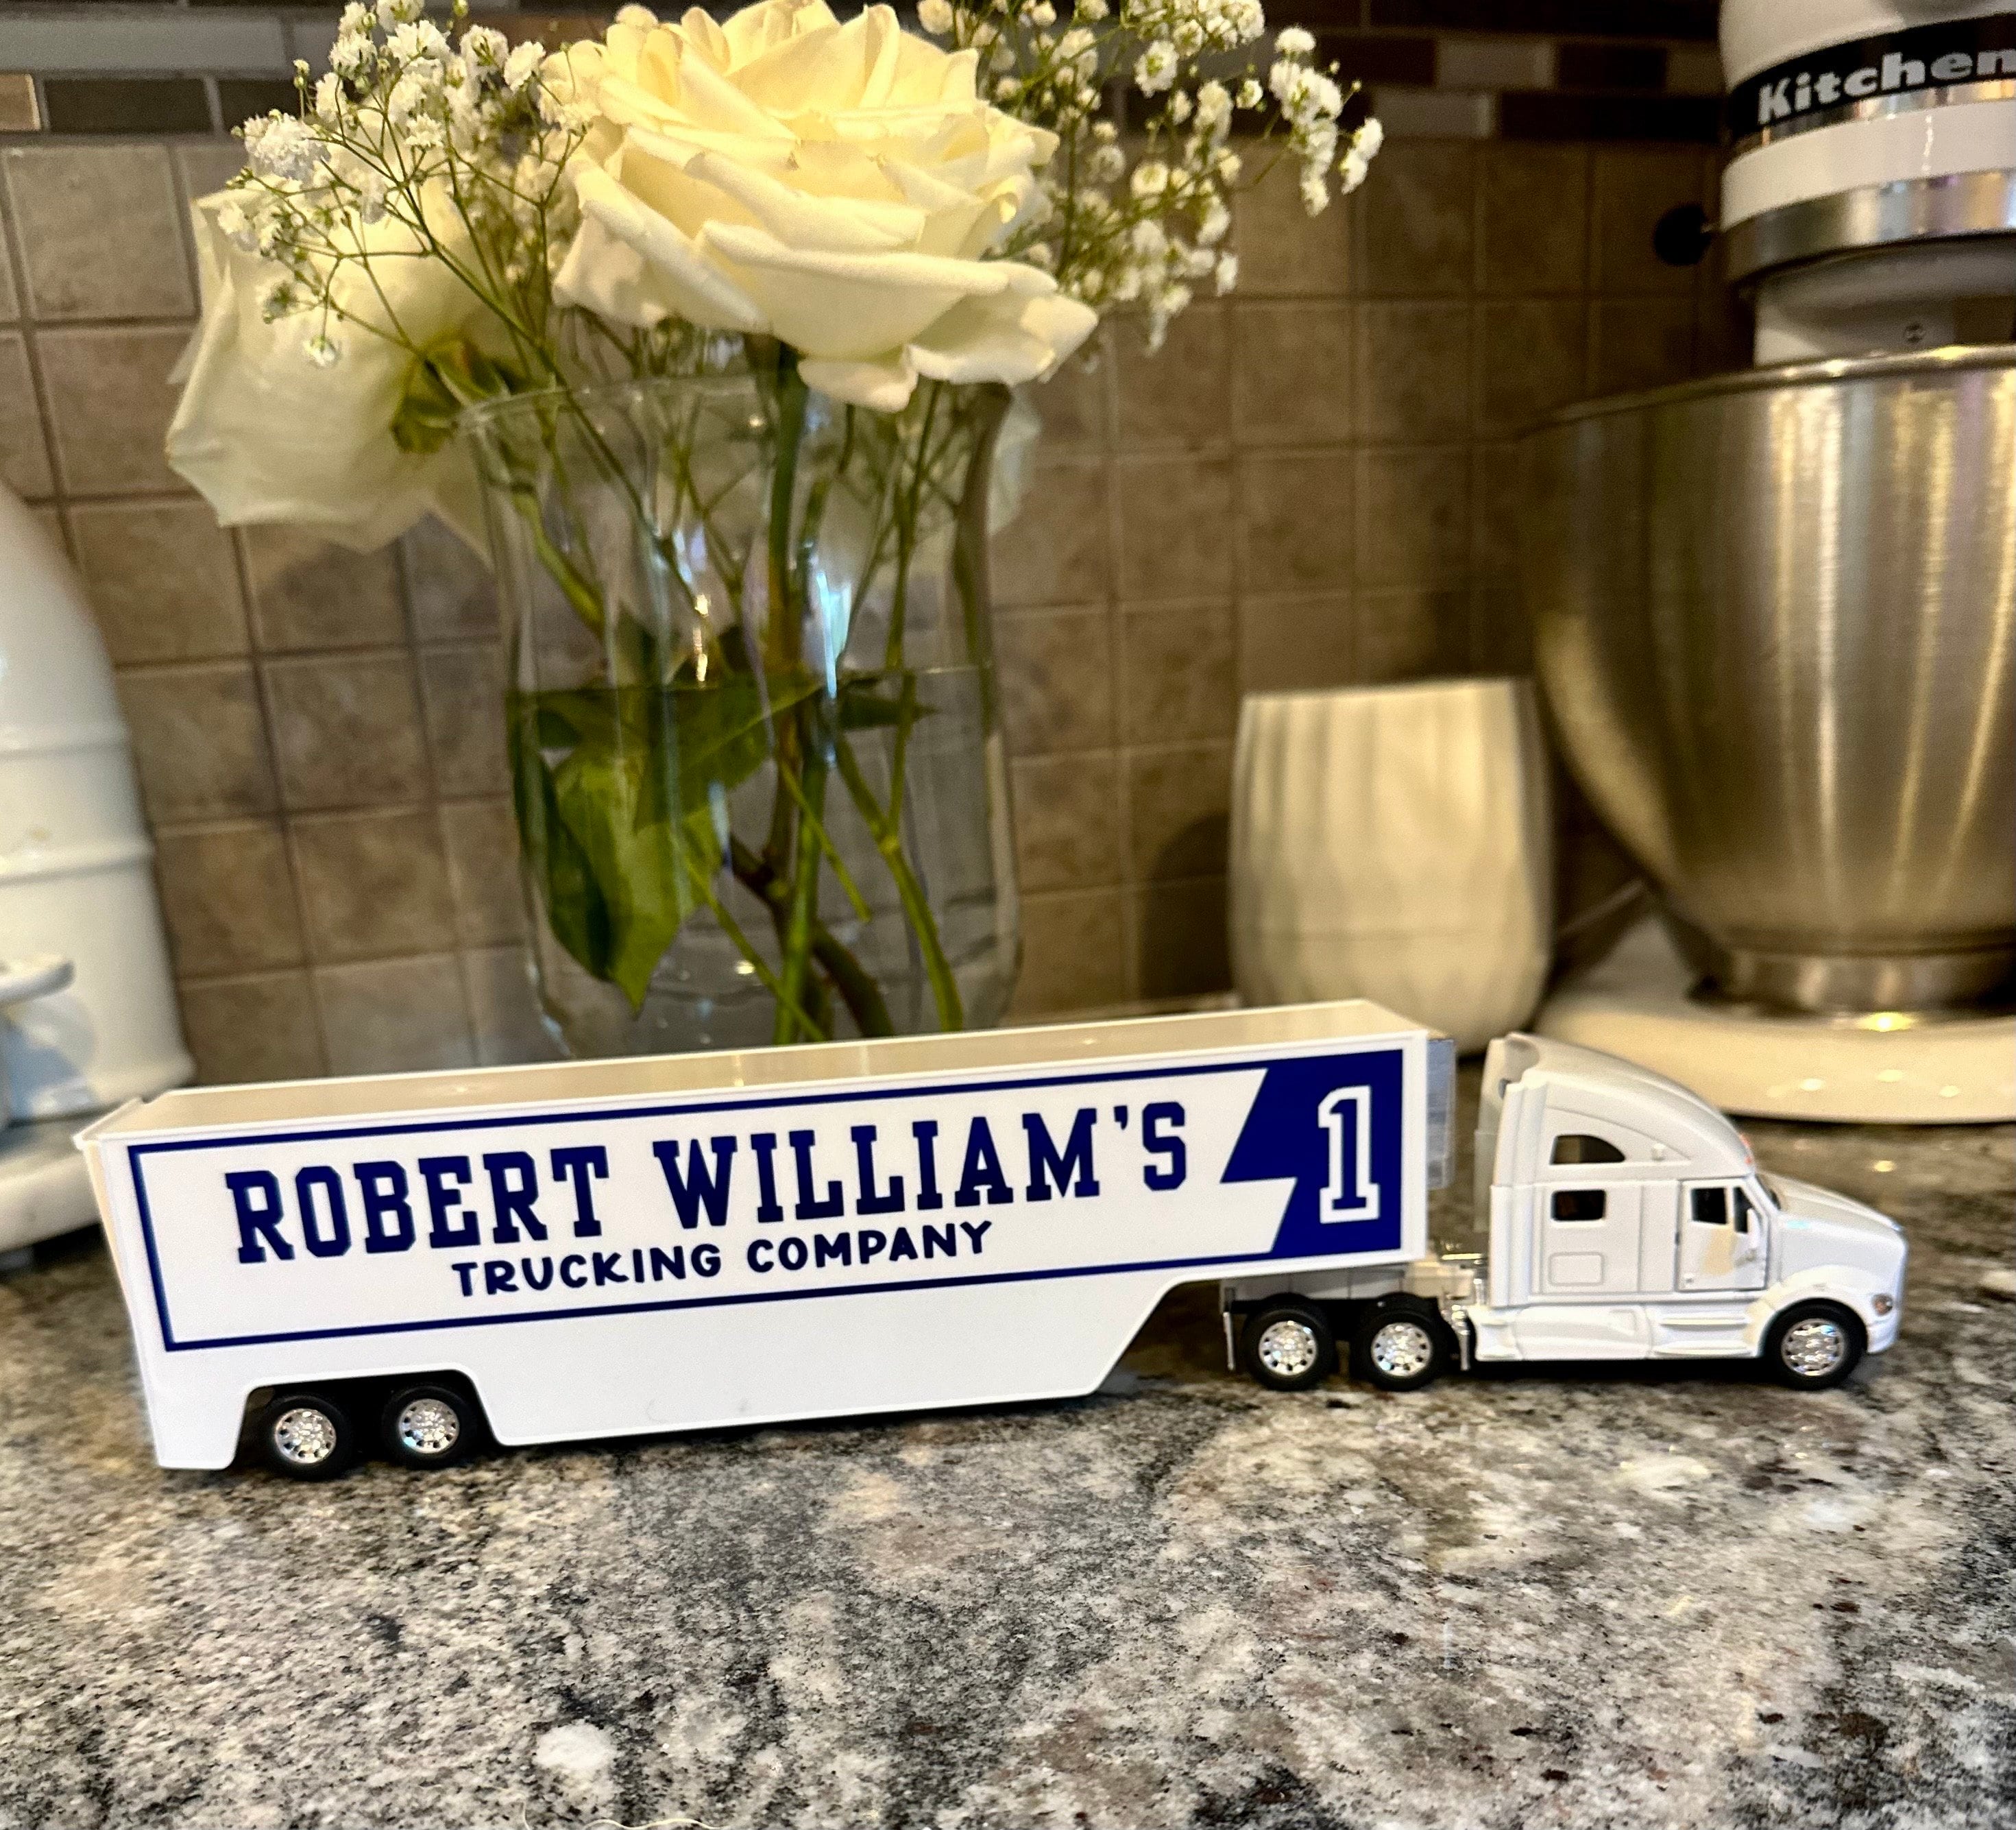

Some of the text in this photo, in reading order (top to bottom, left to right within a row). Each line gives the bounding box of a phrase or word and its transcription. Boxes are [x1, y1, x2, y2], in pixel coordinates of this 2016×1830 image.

[1758, 49, 2016, 125] Kitchen
[225, 1102, 1187, 1264] ROBERT WILLIAM'S
[1317, 1085, 1380, 1224] 1
[452, 1220, 993, 1297] TRUCKING COMPANY
